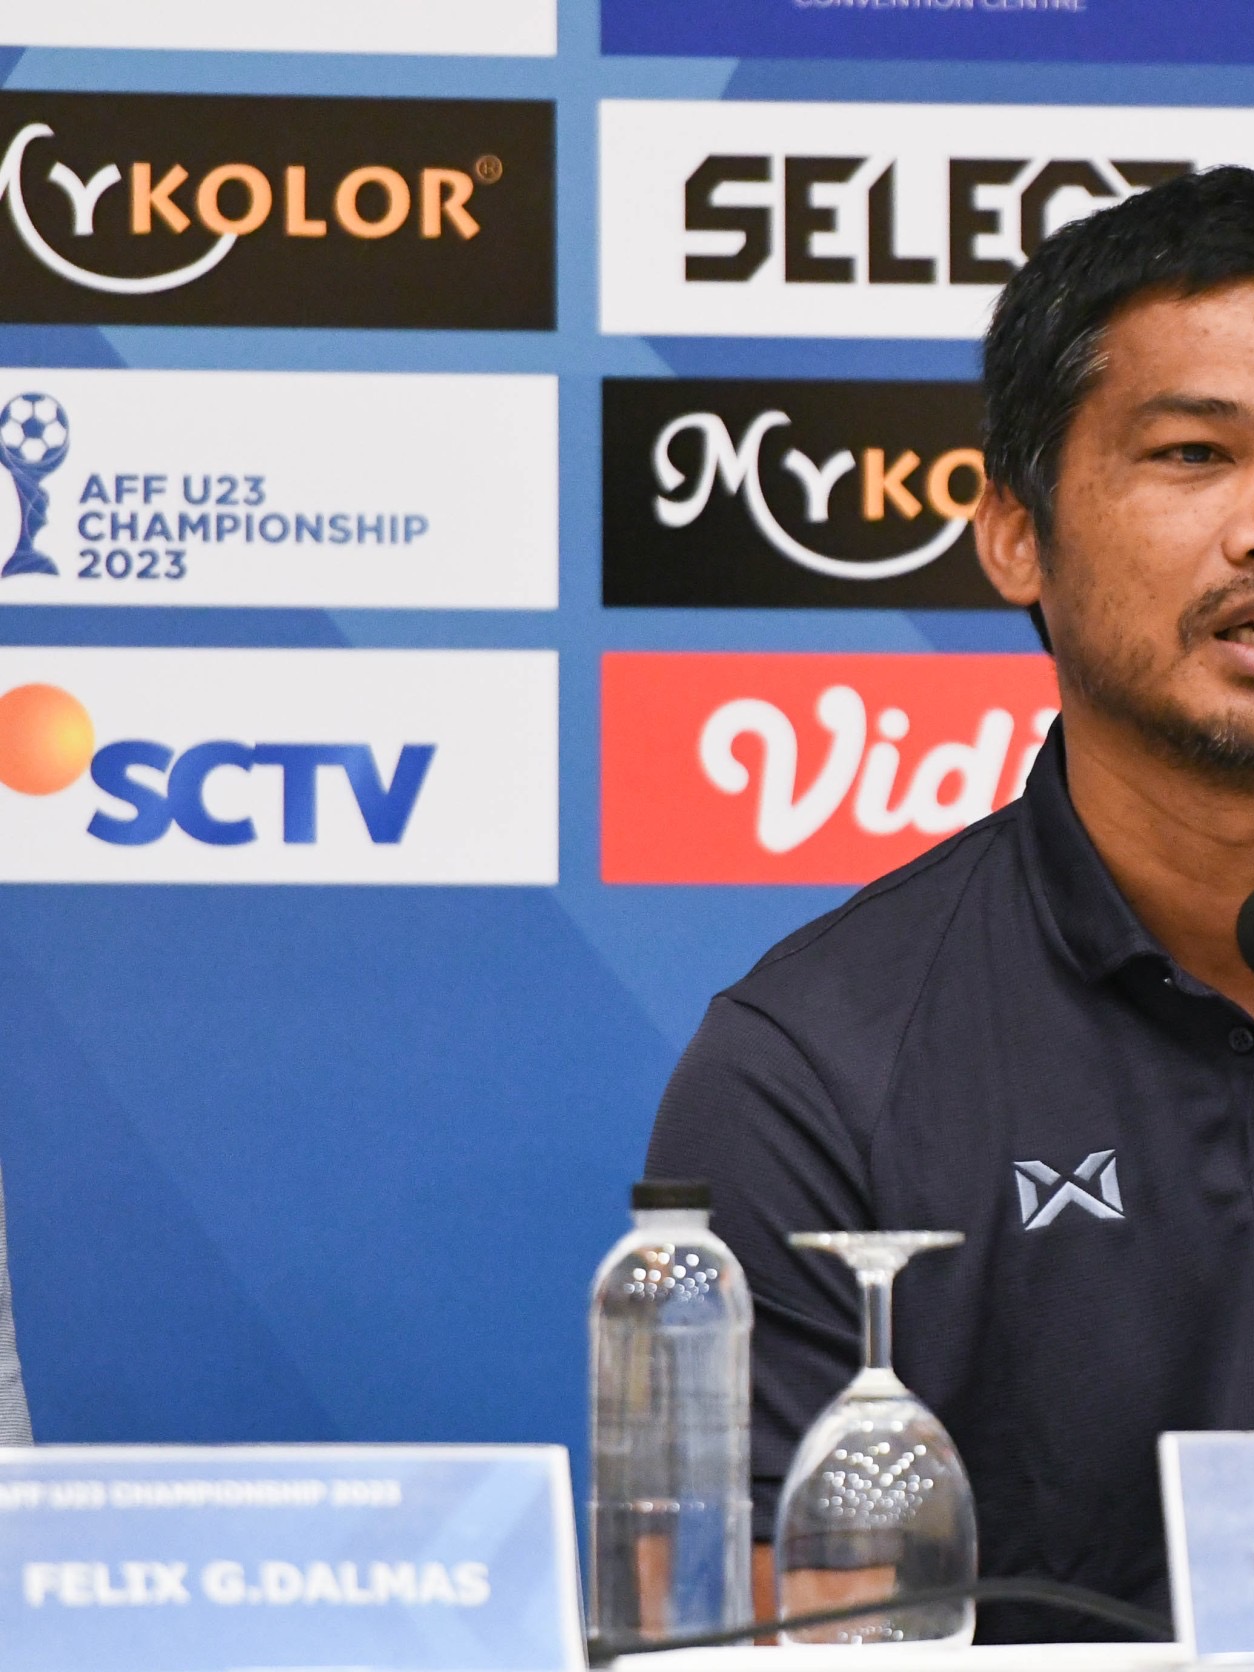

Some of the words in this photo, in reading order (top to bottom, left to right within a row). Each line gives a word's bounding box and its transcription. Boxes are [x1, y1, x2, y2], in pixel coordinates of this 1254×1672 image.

[79, 475, 167, 505] AFF
[183, 475, 267, 506] U23
[78, 512, 430, 545] CHAMPIONSHIP
[78, 550, 188, 580] 2023
[87, 740, 437, 847] SCTV
[24, 1562, 190, 1605] FELIX
[203, 1561, 491, 1605] G.DALMAS
